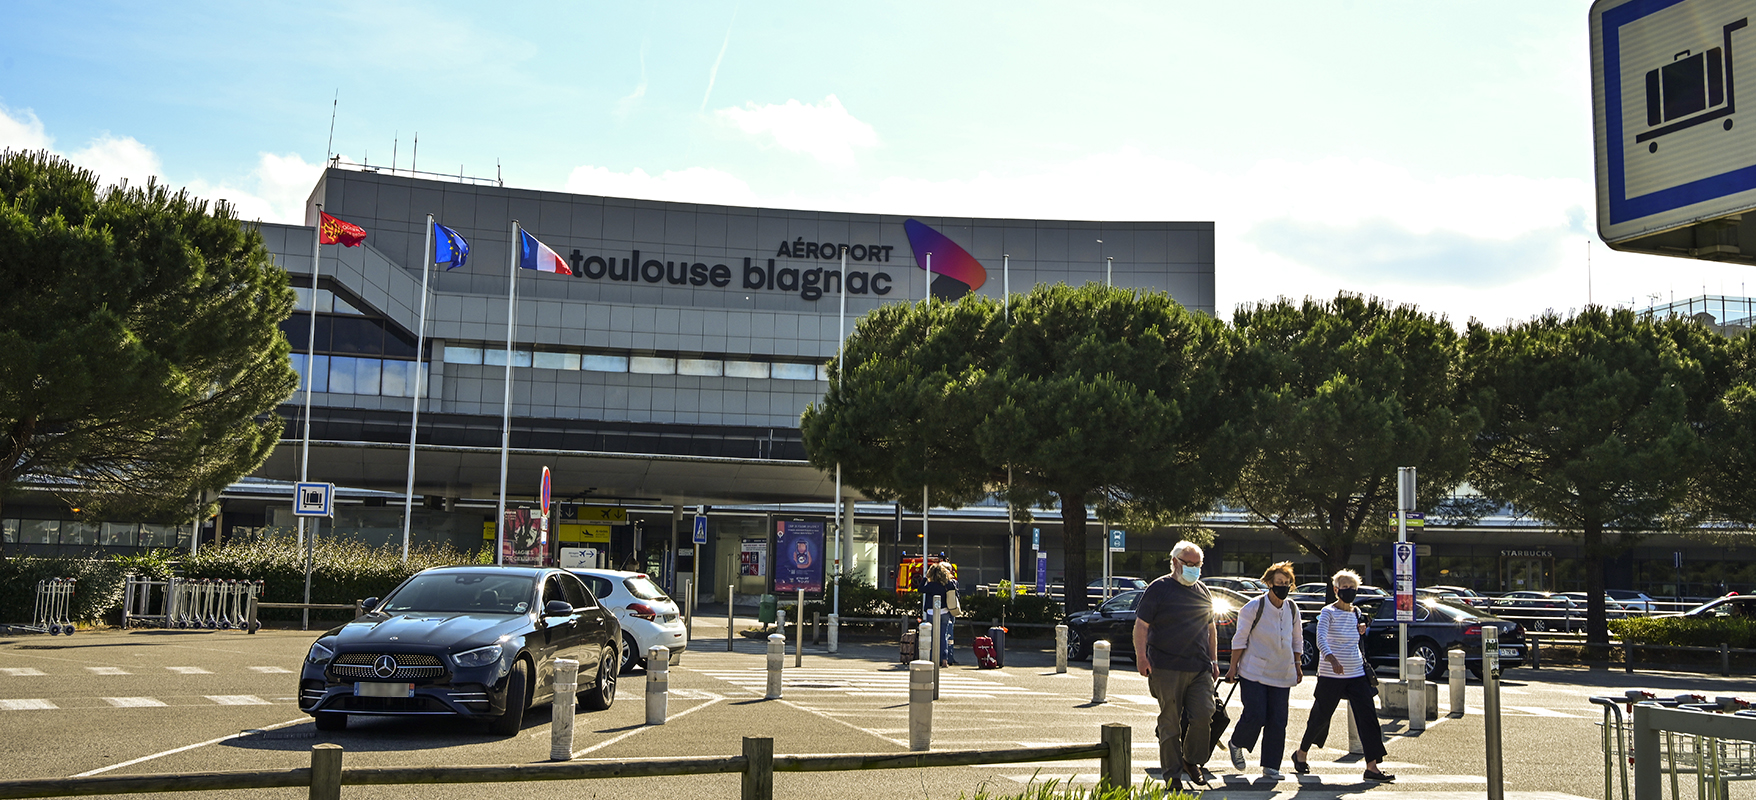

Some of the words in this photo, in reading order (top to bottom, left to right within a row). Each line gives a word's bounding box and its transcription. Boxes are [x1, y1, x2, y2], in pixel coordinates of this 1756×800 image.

[777, 236, 894, 262] AÉROPORT
[570, 249, 731, 287] toulouse
[743, 257, 892, 301] blagnac
